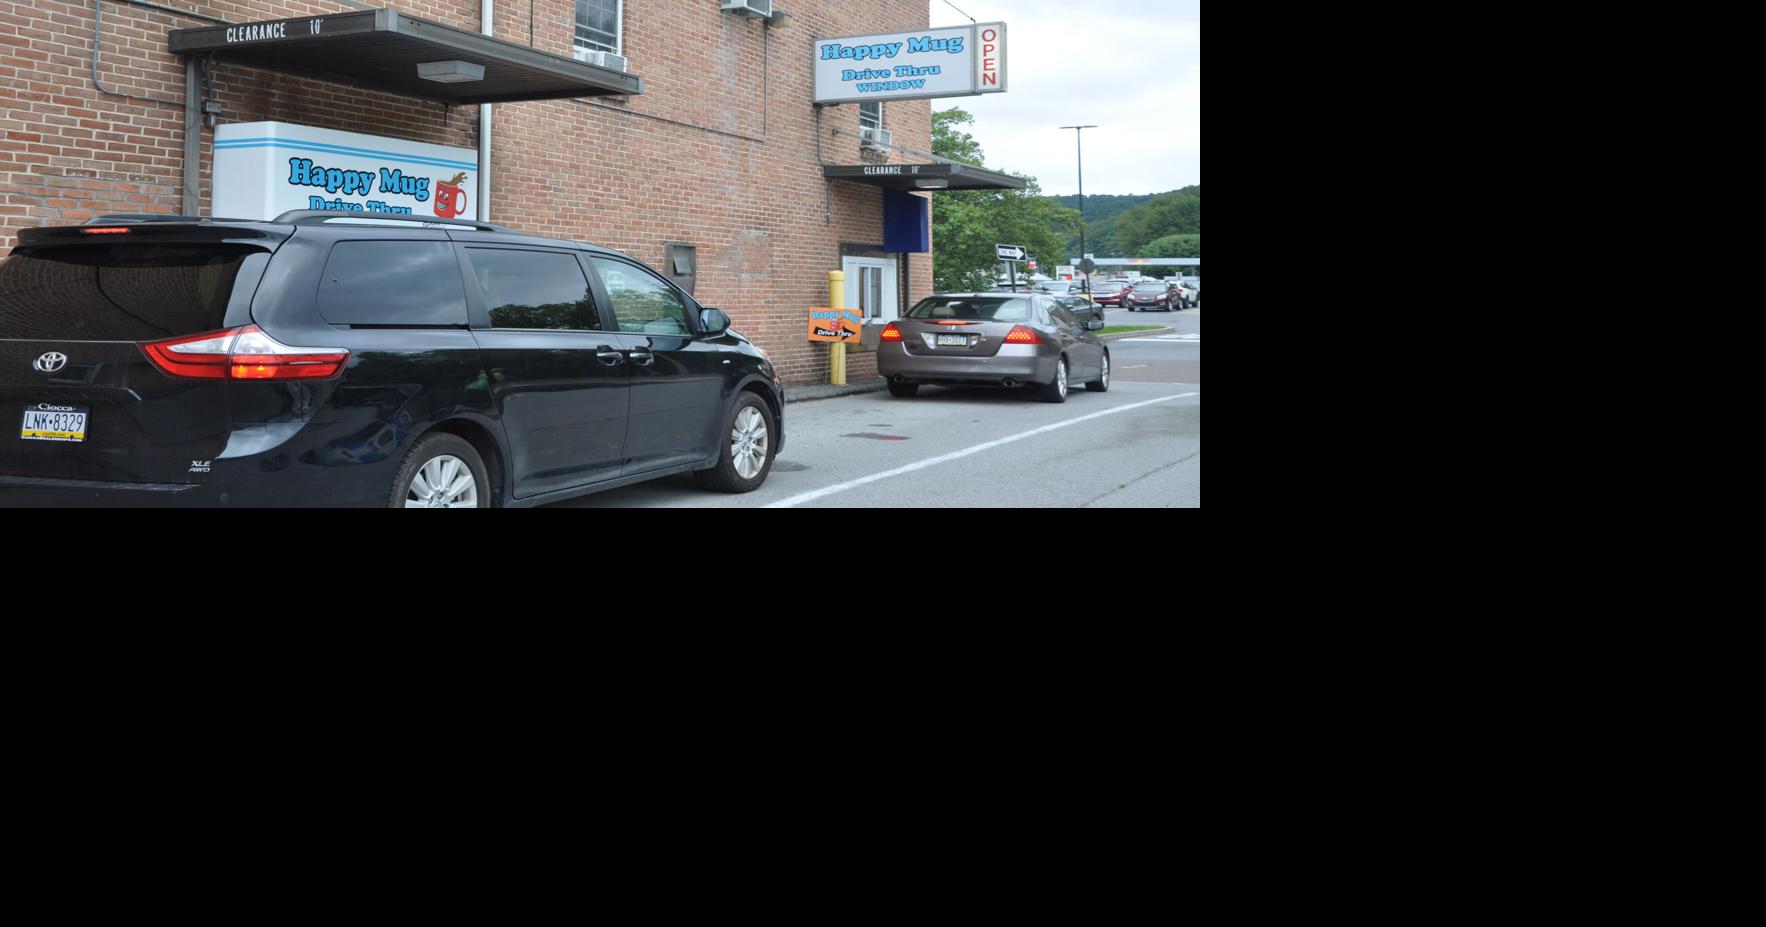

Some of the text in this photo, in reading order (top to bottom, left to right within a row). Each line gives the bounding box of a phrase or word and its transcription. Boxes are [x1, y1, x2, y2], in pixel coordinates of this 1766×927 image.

[226, 22, 287, 43] CLEARANCE
[821, 36, 965, 60] Happy Mug
[981, 28, 997, 86] OPEN
[841, 65, 942, 81] Drive Thru
[856, 79, 926, 92] WINDOW
[863, 165, 902, 175] CLEARANCE
[288, 157, 431, 202] Happy Mug
[308, 195, 364, 213] Drive
[817, 329, 836, 337] Drive
[38, 403, 74, 411] Ciocca
